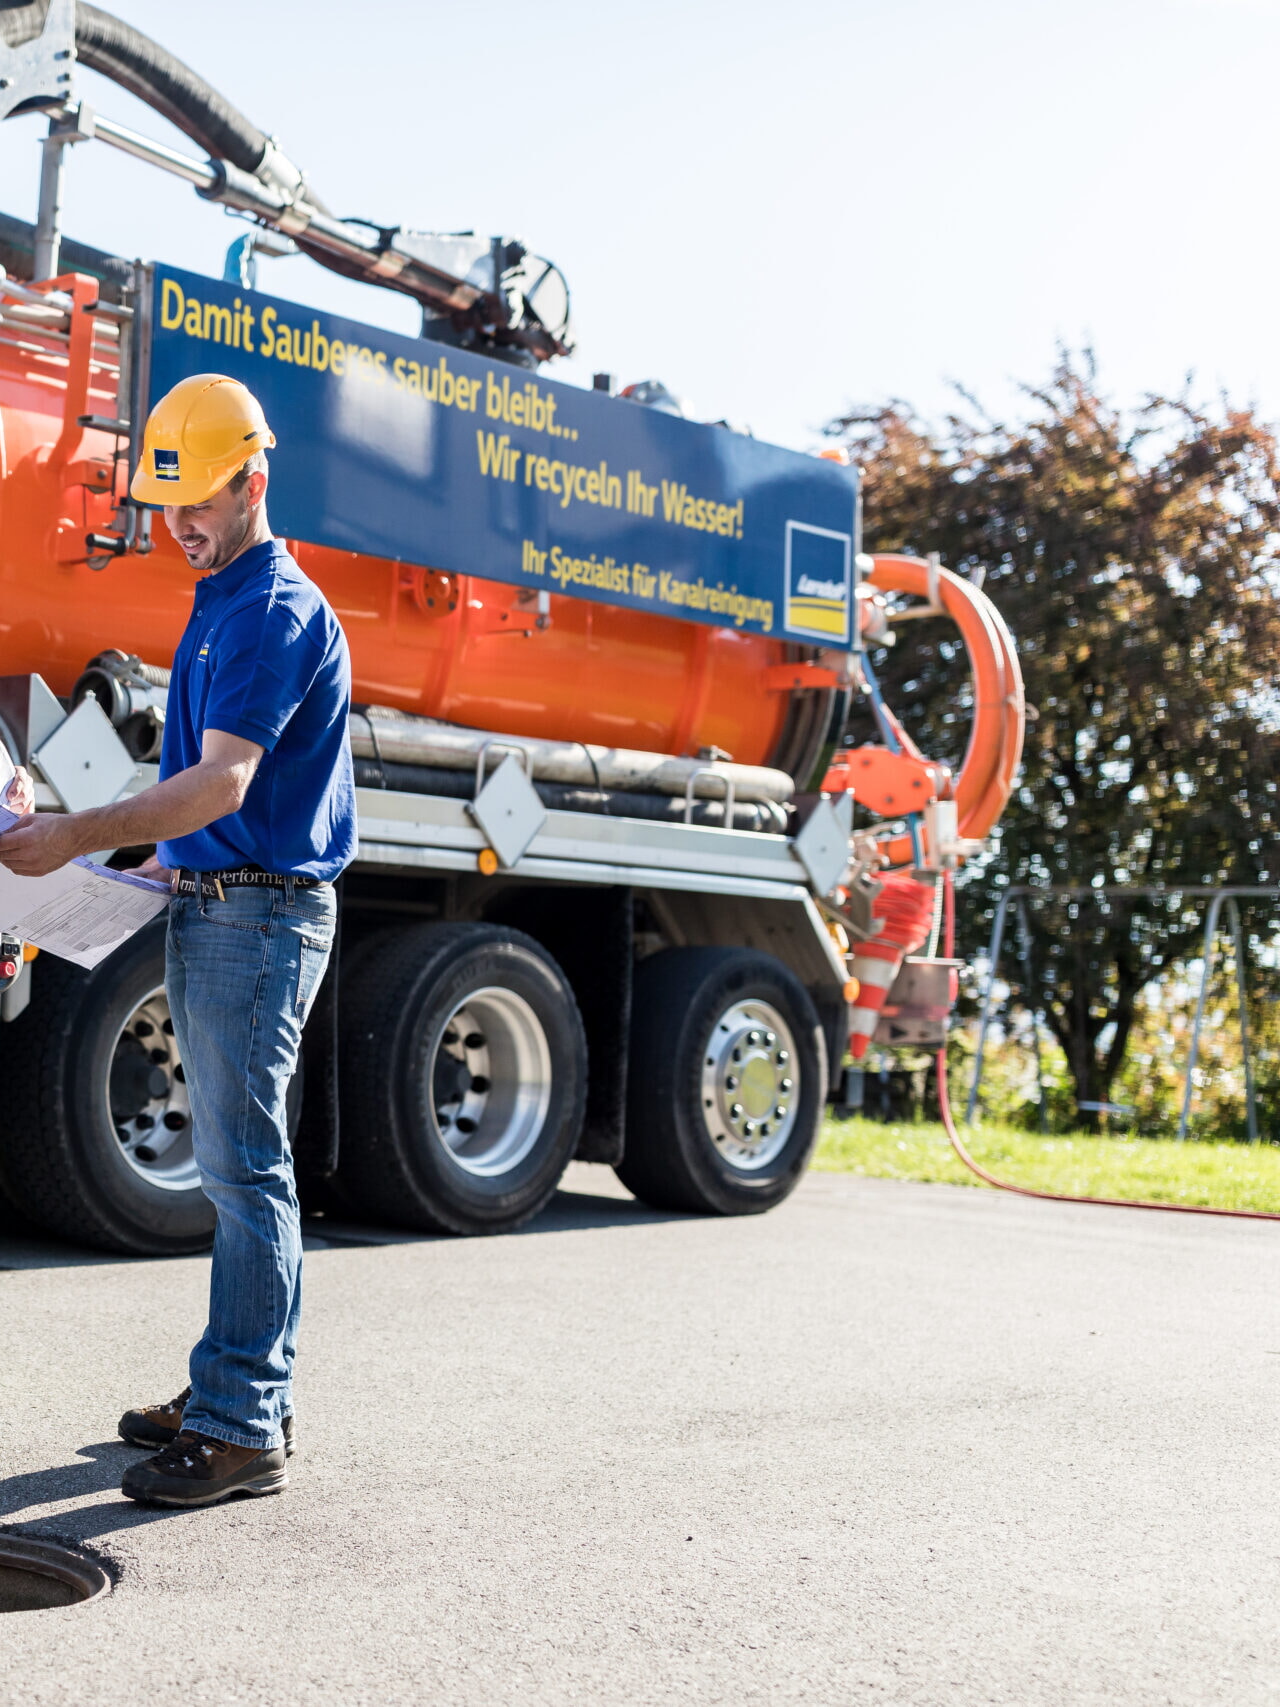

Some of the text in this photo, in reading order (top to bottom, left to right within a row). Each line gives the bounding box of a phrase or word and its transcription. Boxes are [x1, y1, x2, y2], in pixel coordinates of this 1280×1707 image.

[161, 278, 579, 441] Damit Sauberes sauber bleibt...
[477, 430, 745, 539] Wir recyceln Ihr Wasser!
[522, 540, 773, 632] Ihr Spezialist für Kanalreinigung
